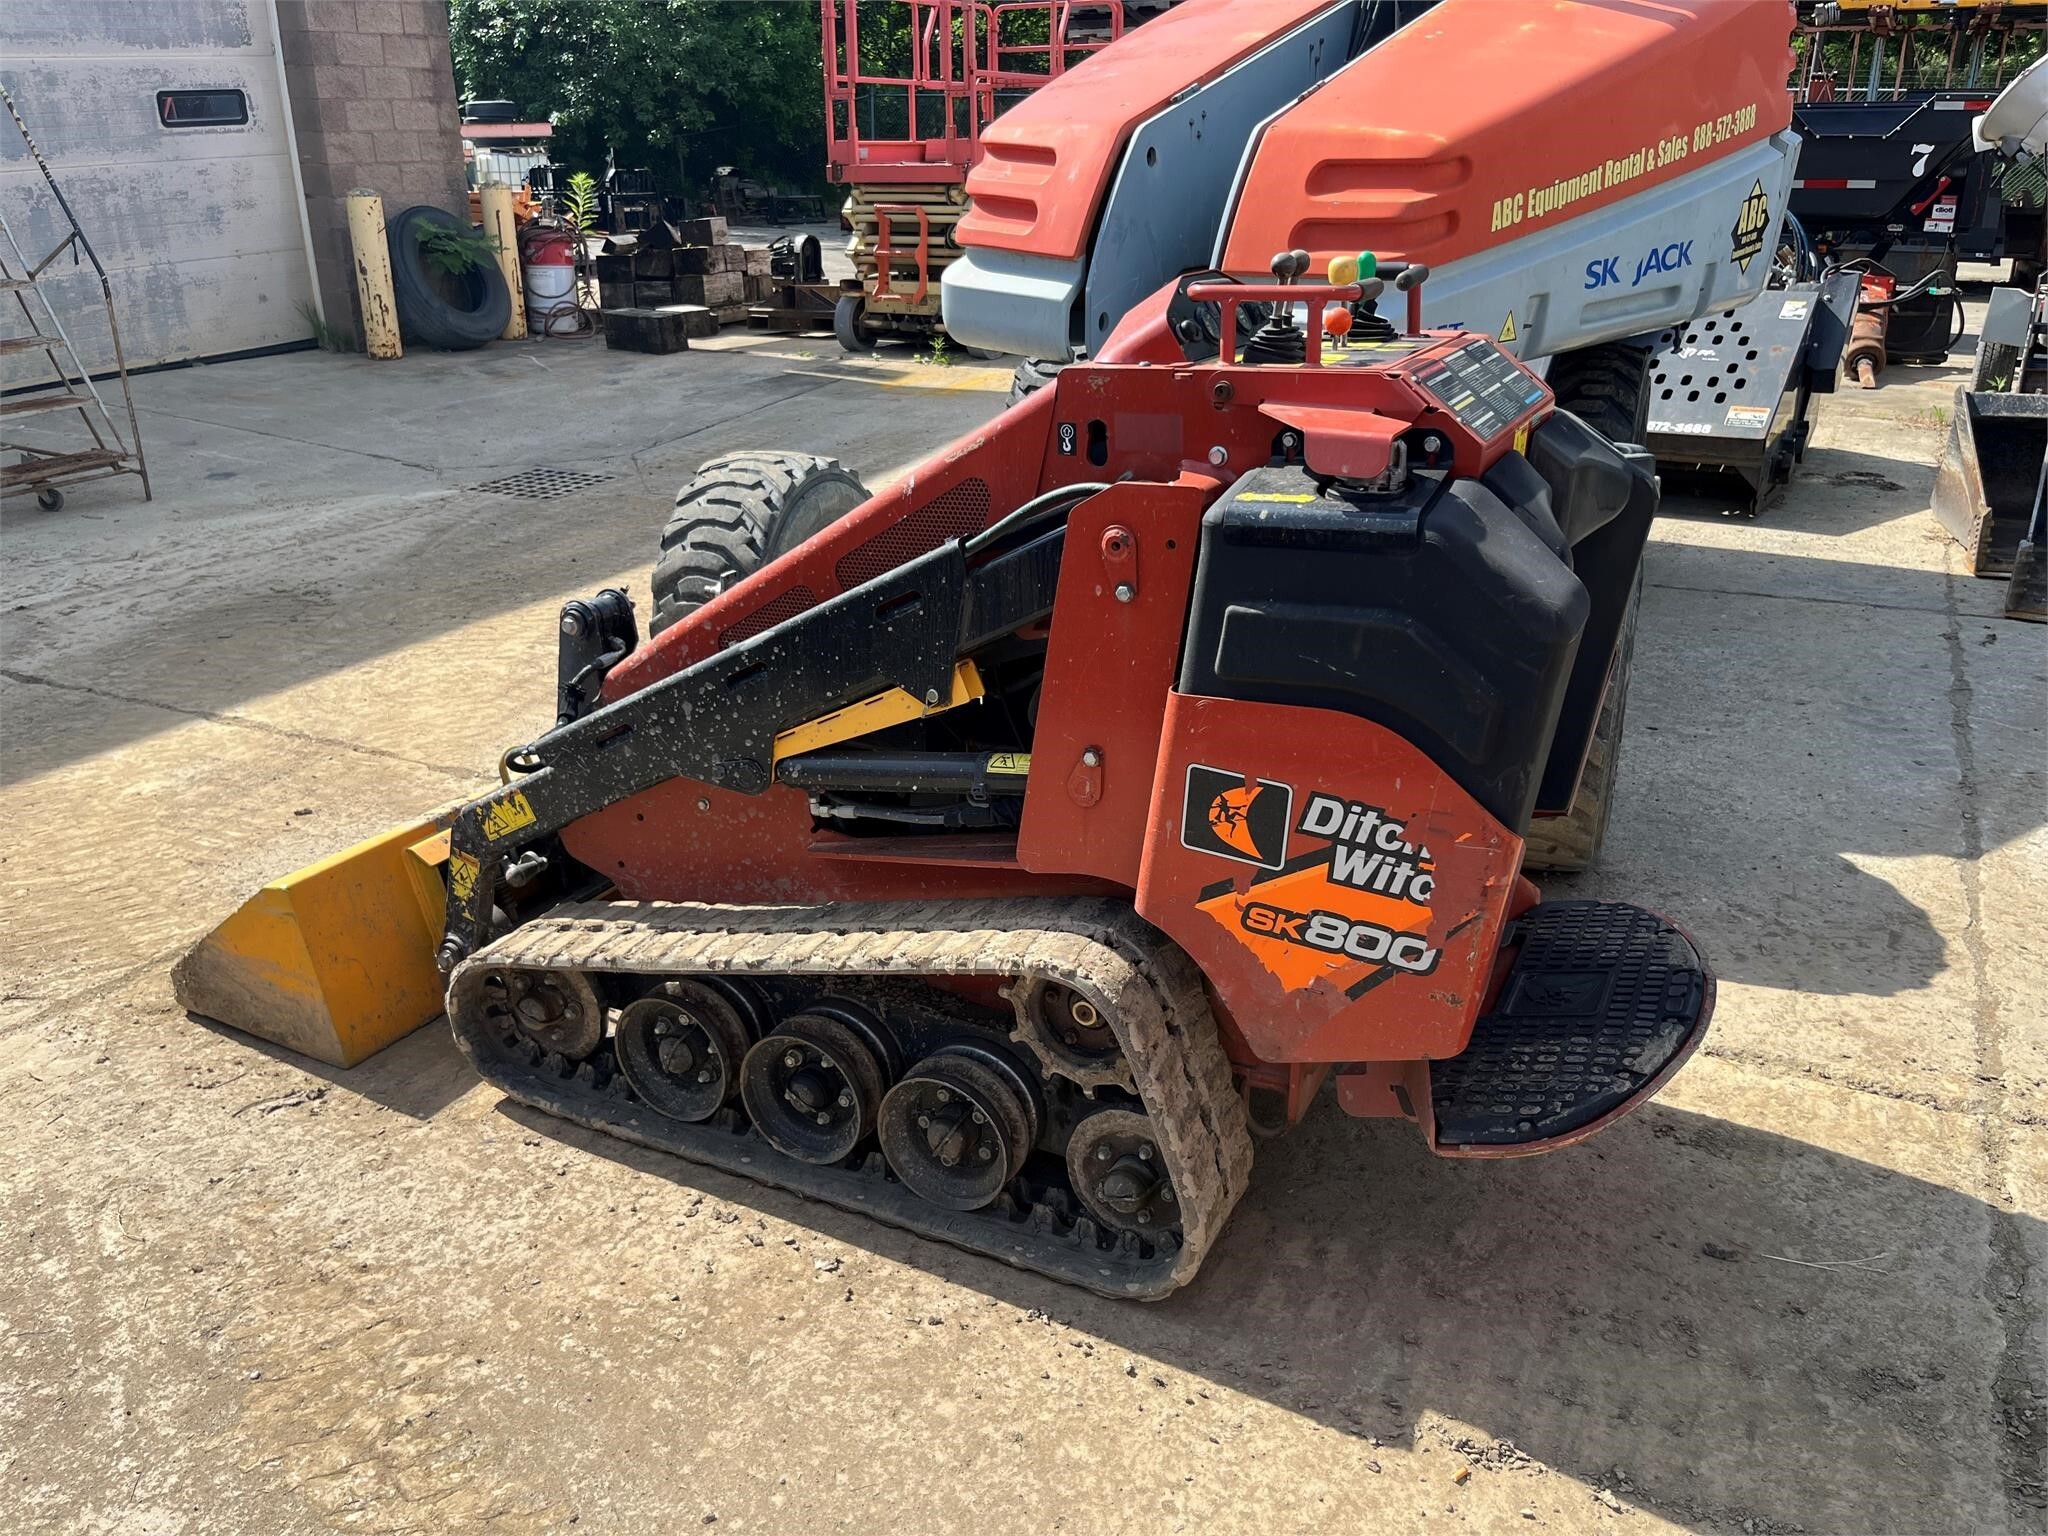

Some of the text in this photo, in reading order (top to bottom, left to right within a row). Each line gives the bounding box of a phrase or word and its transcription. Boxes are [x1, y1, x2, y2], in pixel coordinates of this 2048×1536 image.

[1491, 103, 1757, 232] ABC Equipment Rental & Sales 888-572-3888
[1910, 143, 1936, 178] 7
[1737, 195, 1767, 235] ABC
